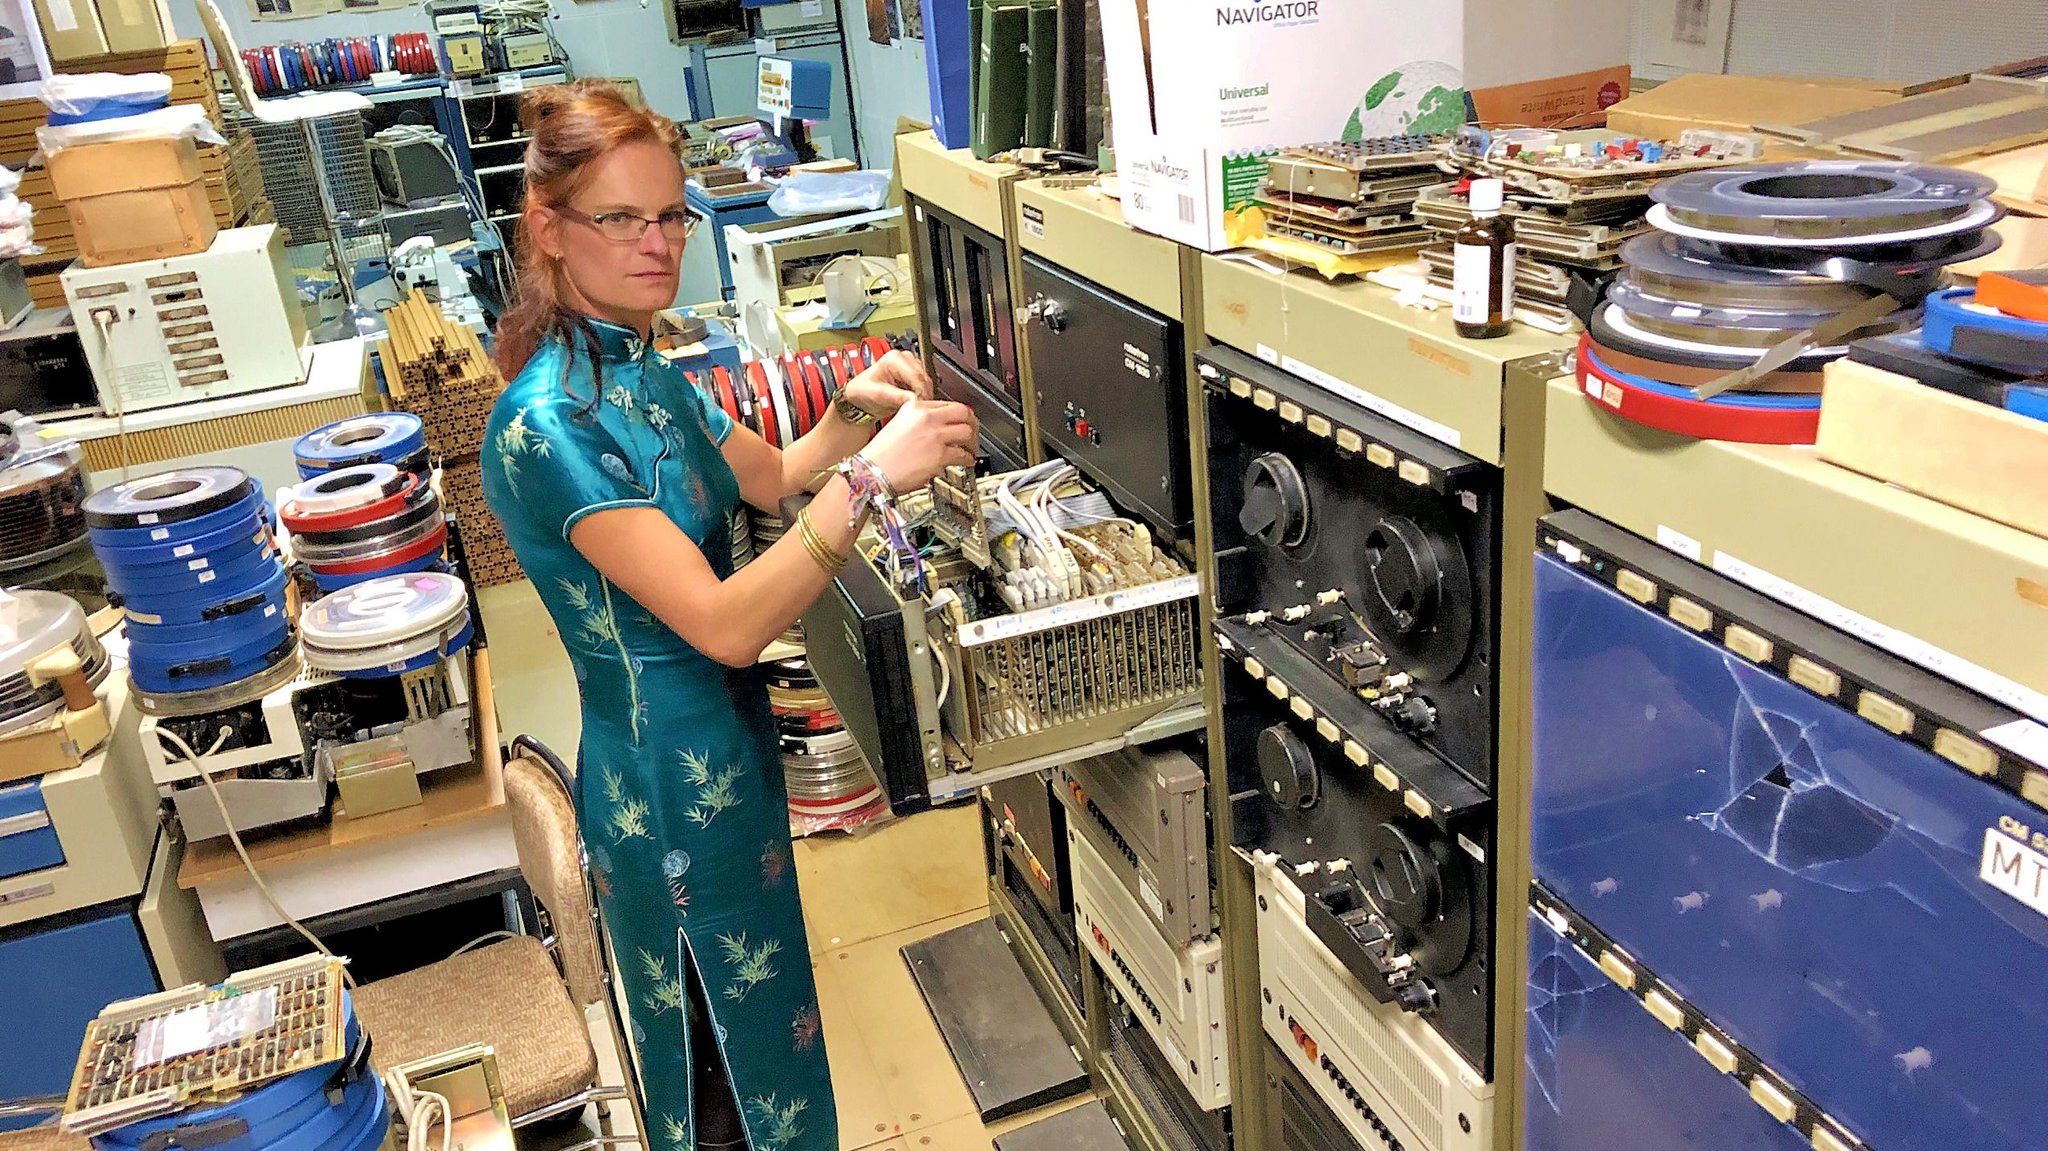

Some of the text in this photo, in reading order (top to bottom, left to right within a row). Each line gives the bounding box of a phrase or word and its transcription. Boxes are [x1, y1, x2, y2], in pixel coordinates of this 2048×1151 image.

[1216, 1, 1318, 26] NAVIGATOR
[1219, 82, 1269, 101] Universal
[1521, 94, 1586, 113] TrendWhite
[1151, 160, 1189, 181] NAVIGATOR
[1133, 192, 1144, 210] 80
[1123, 341, 1149, 363] robotron
[1999, 815, 2029, 841] CM
